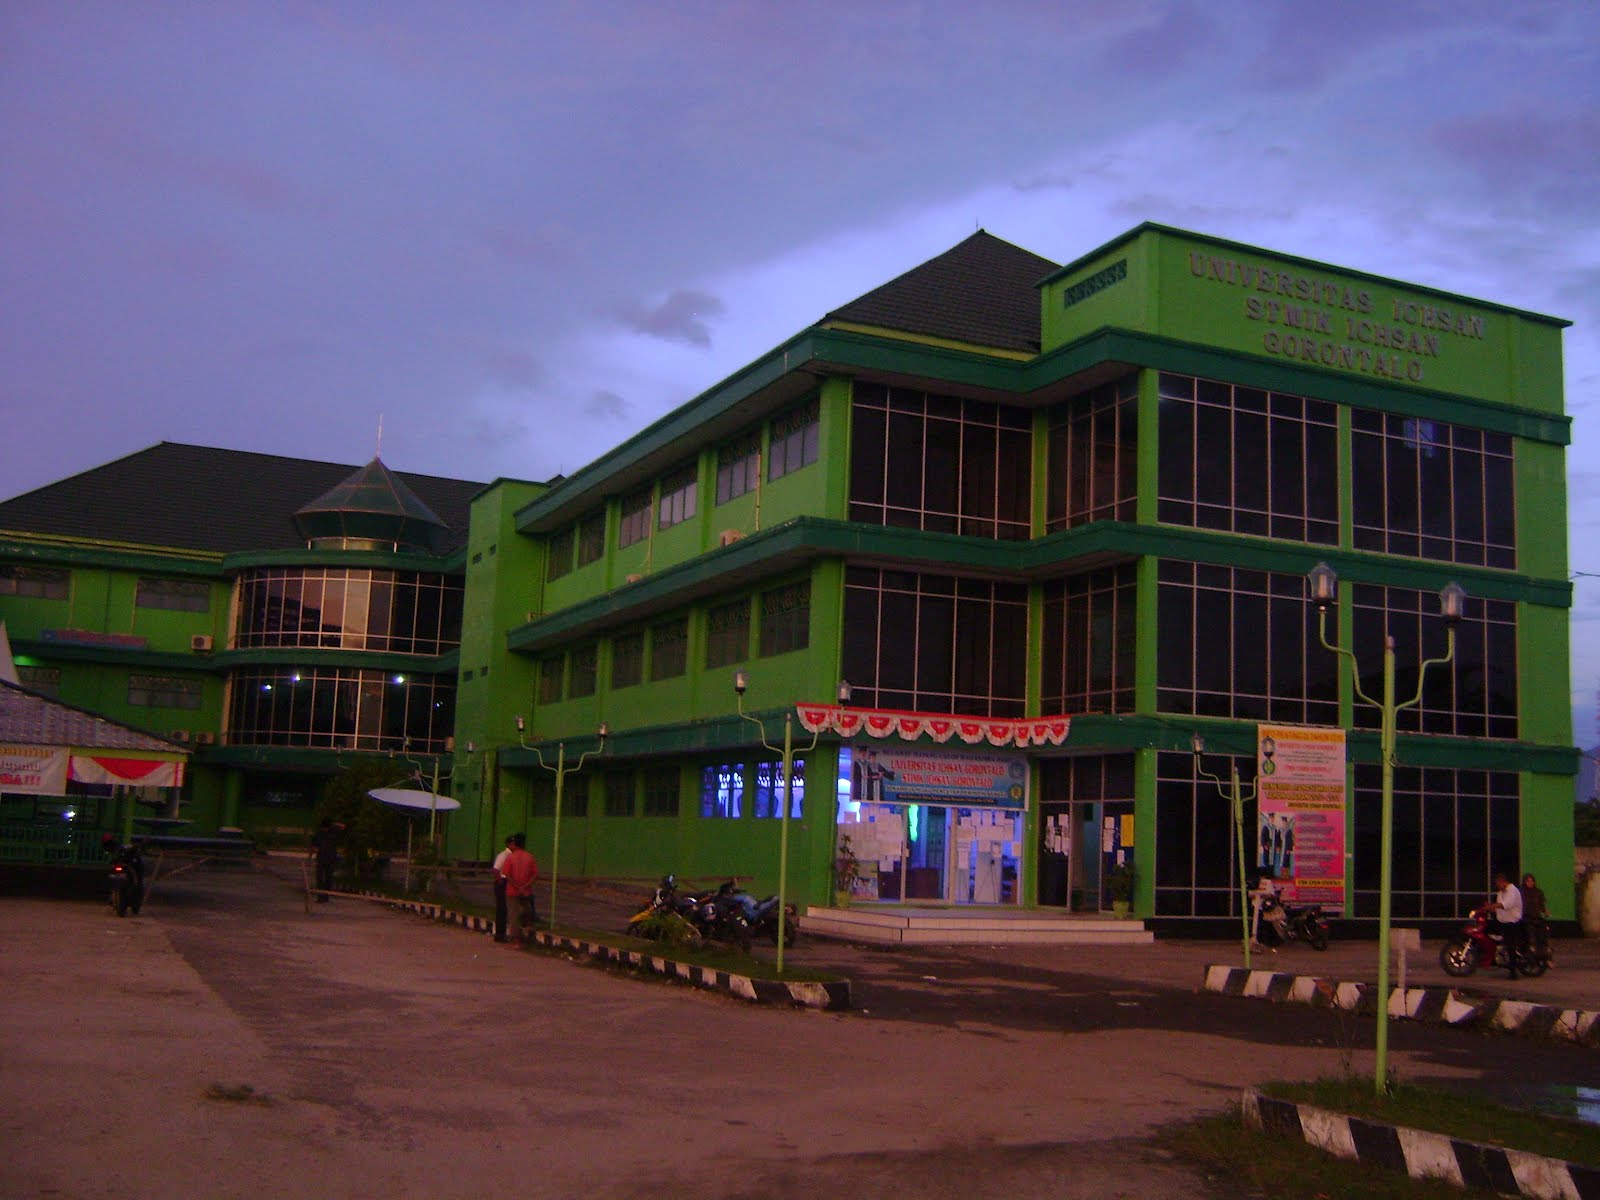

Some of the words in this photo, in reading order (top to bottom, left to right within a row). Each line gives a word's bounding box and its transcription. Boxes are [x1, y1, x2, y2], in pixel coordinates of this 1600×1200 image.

[1188, 251, 1375, 314] UNIVERSITAS
[1393, 297, 1487, 340] ICHSAN
[1245, 295, 1332, 335] STMIK
[1346, 317, 1440, 357] ICHSAN
[1263, 329, 1425, 383] GORONTALO
